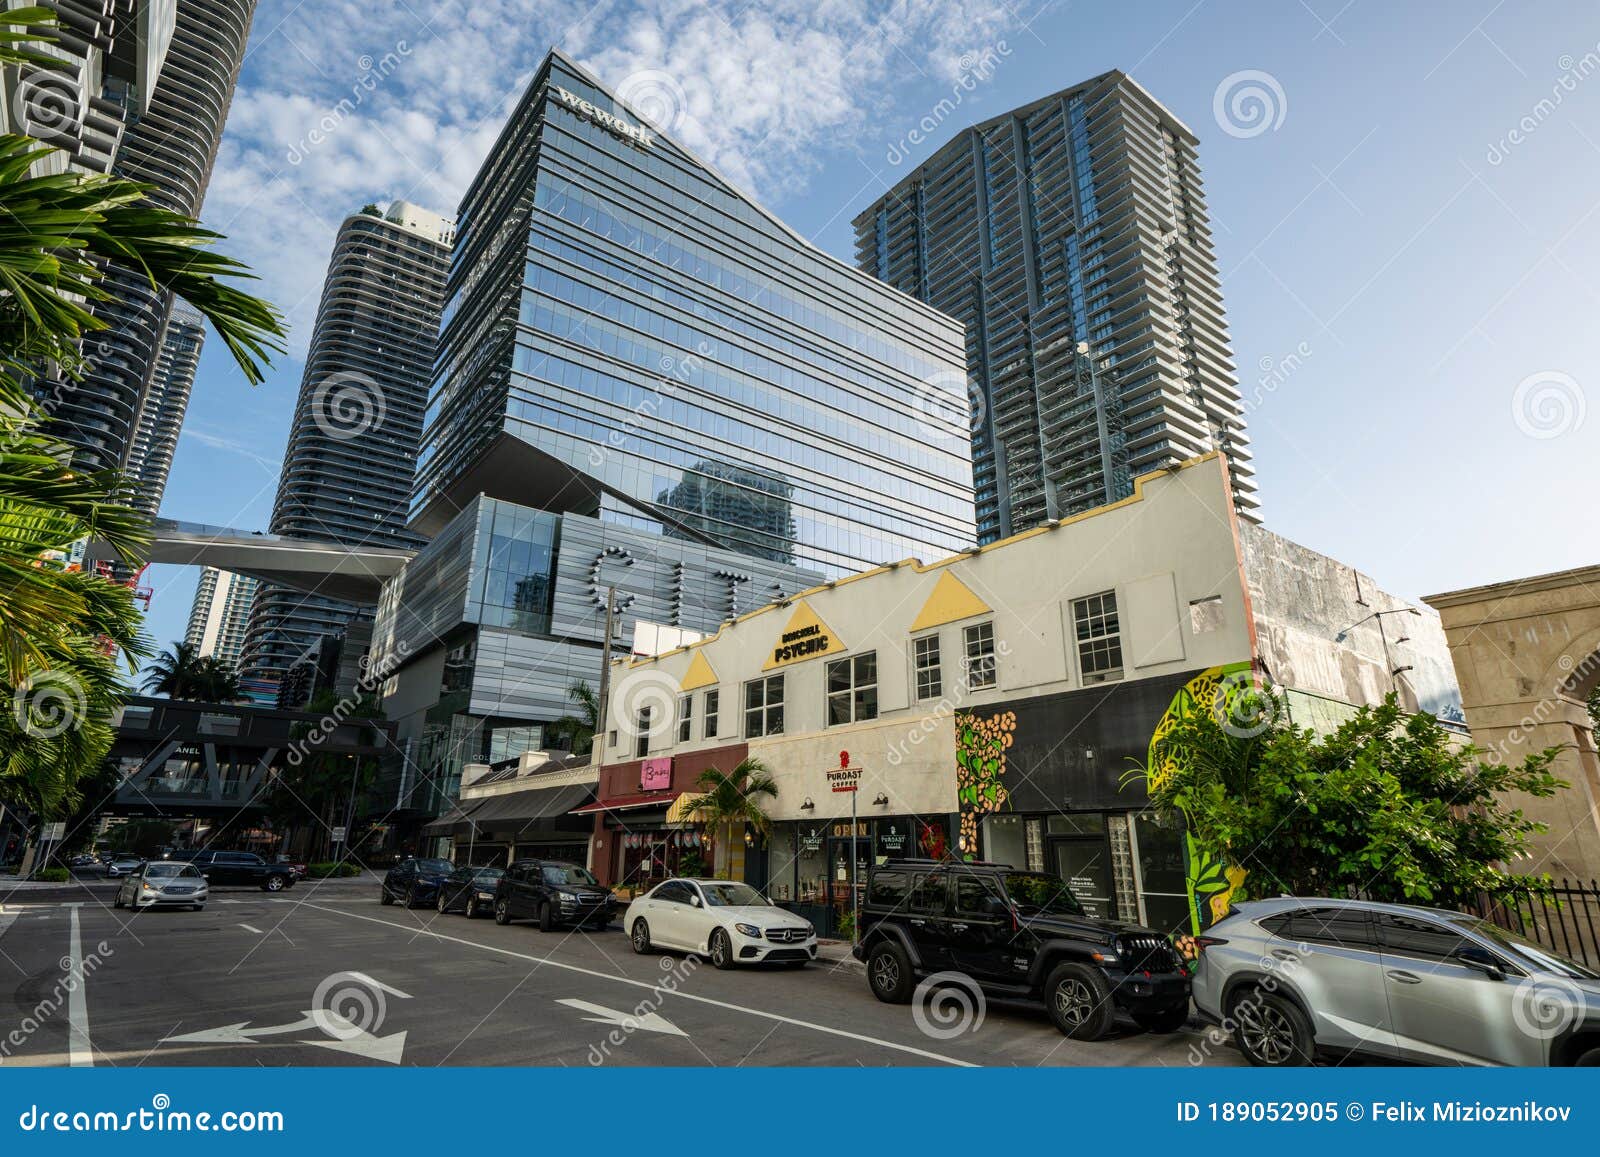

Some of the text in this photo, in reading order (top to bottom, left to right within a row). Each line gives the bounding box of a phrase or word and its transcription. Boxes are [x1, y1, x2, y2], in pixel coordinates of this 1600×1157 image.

[557, 86, 653, 149] wework
[775, 635, 828, 662] PSYCHIC
[826, 770, 863, 781] PUROAST
